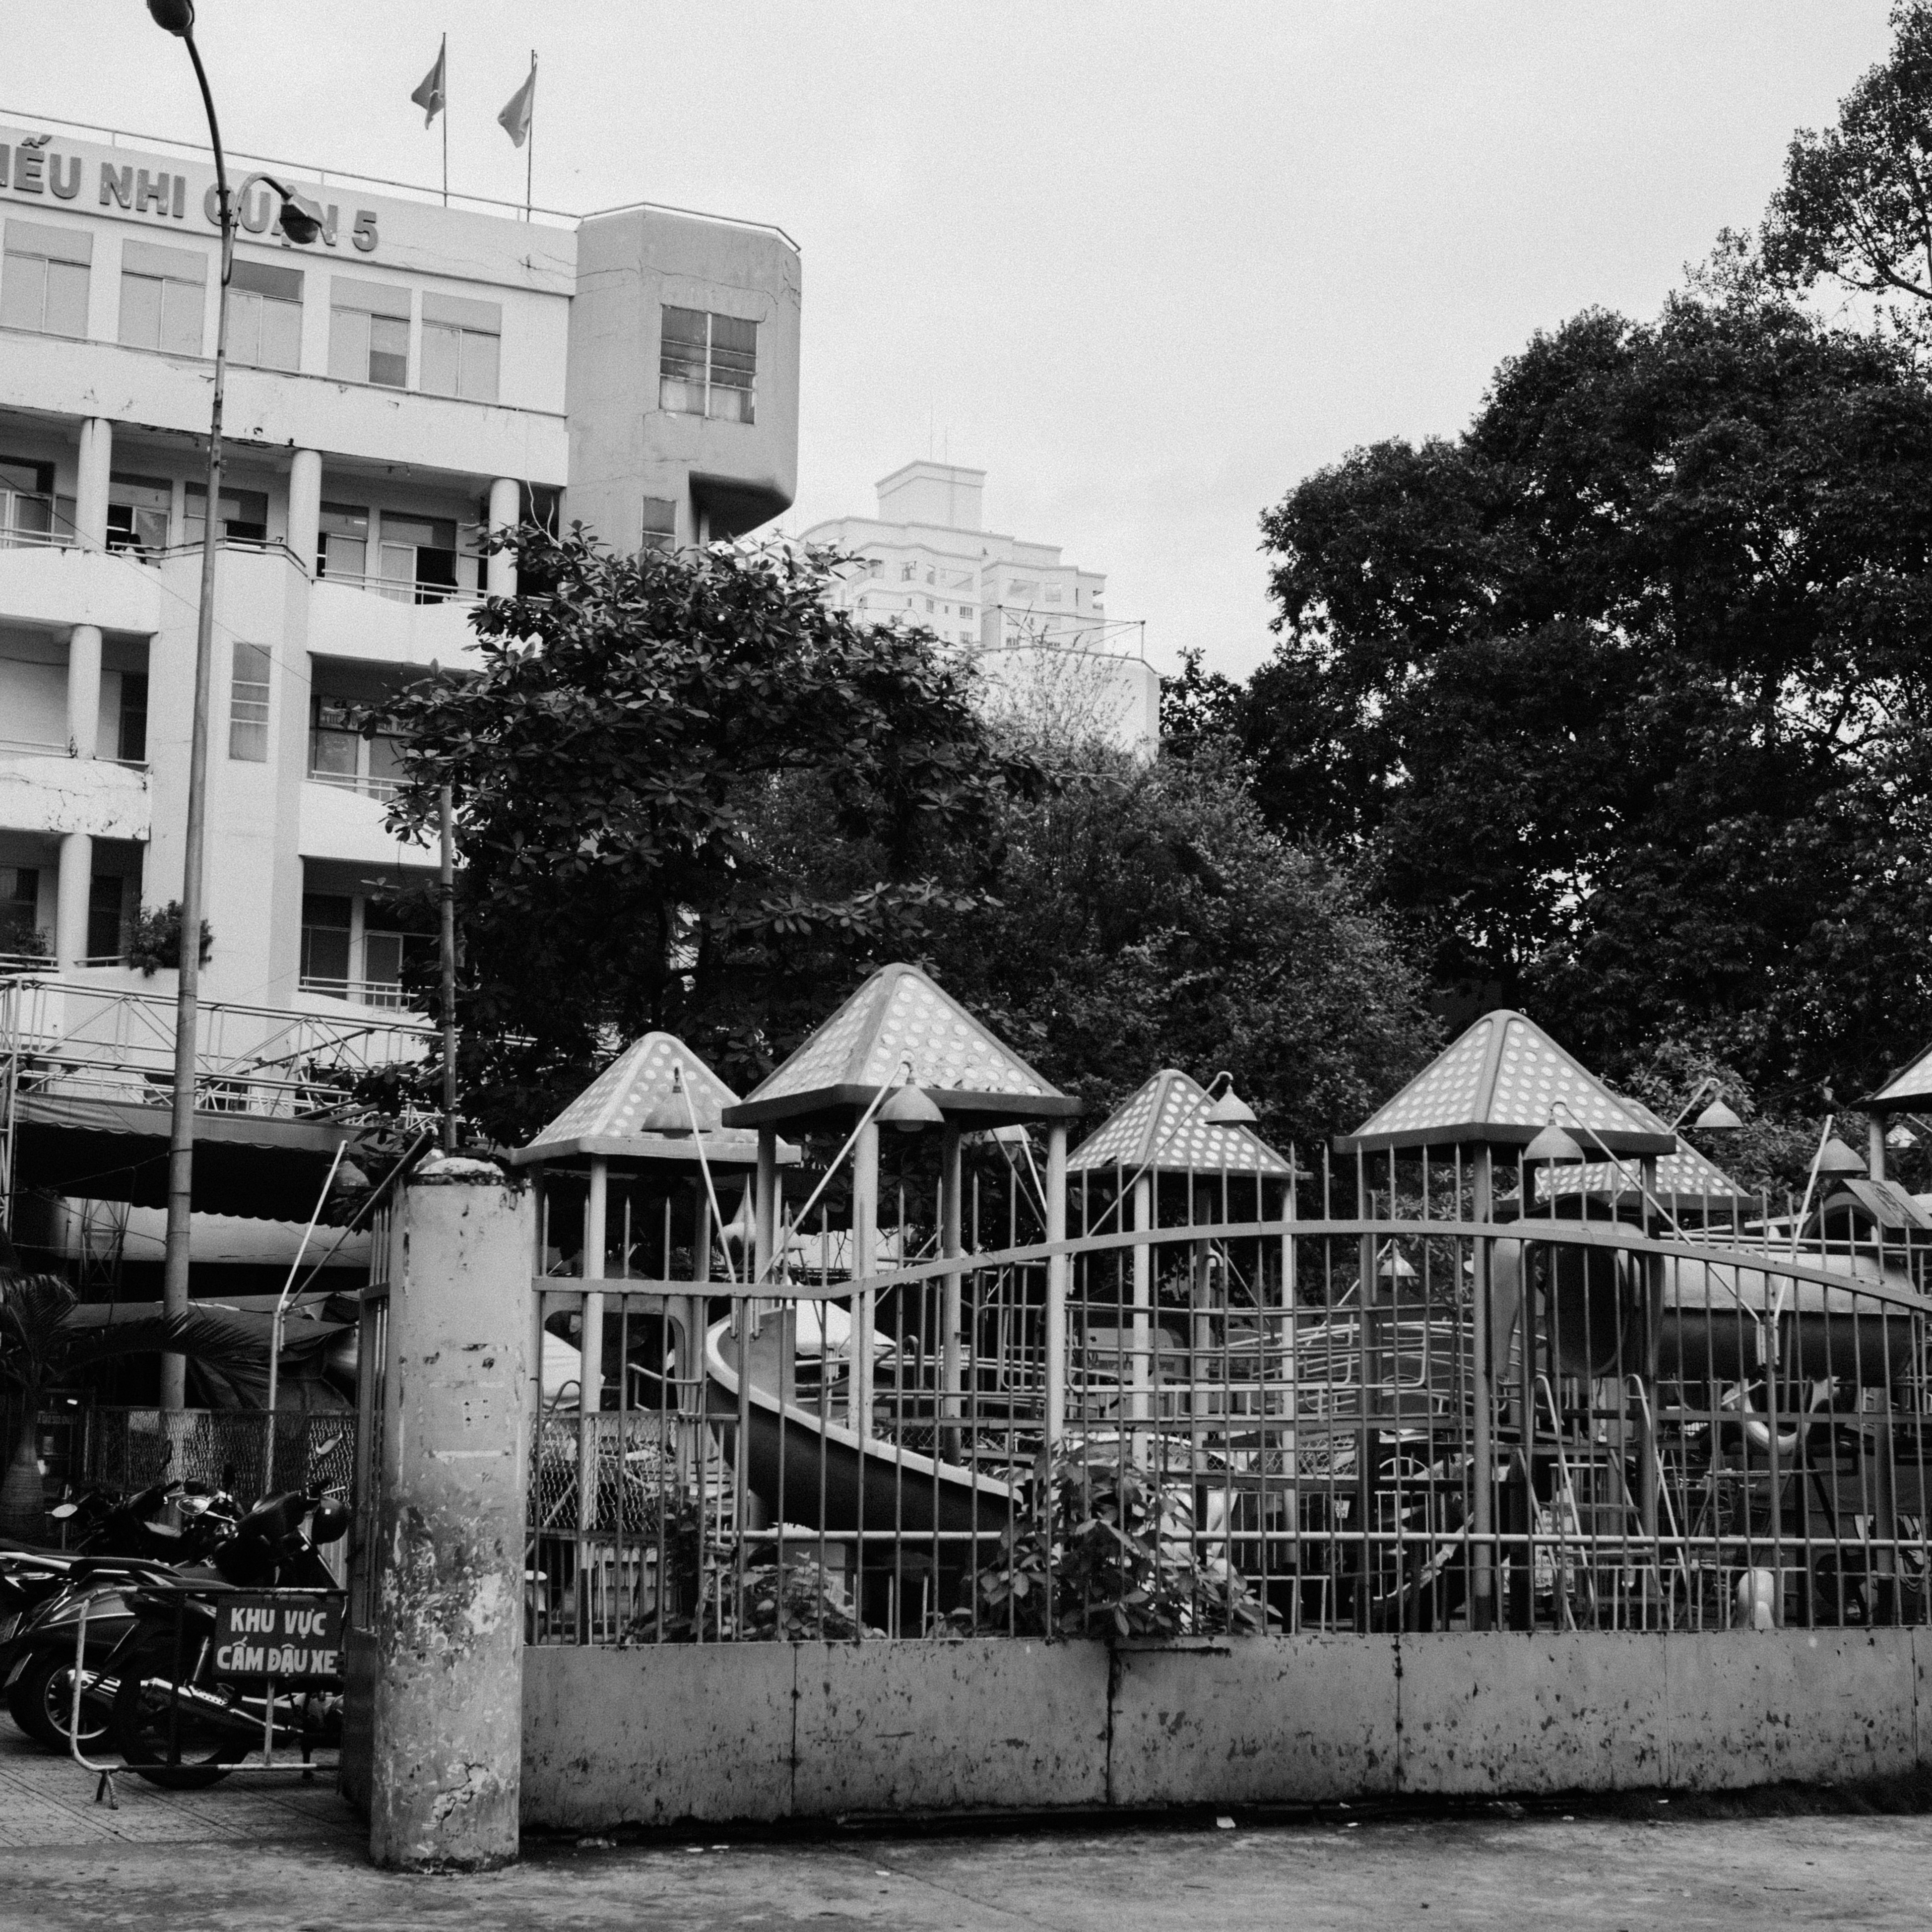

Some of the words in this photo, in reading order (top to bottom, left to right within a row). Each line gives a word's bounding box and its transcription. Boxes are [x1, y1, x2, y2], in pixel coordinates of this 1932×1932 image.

[99, 162, 186, 218] NHI
[203, 182, 338, 247] QUN
[351, 209, 379, 252] 5
[231, 1608, 275, 1633] KHU
[284, 1608, 327, 1639] VỰC
[217, 1635, 264, 1671] CẤM
[267, 1643, 308, 1677] ĐẬU
[310, 1650, 338, 1674] XE
